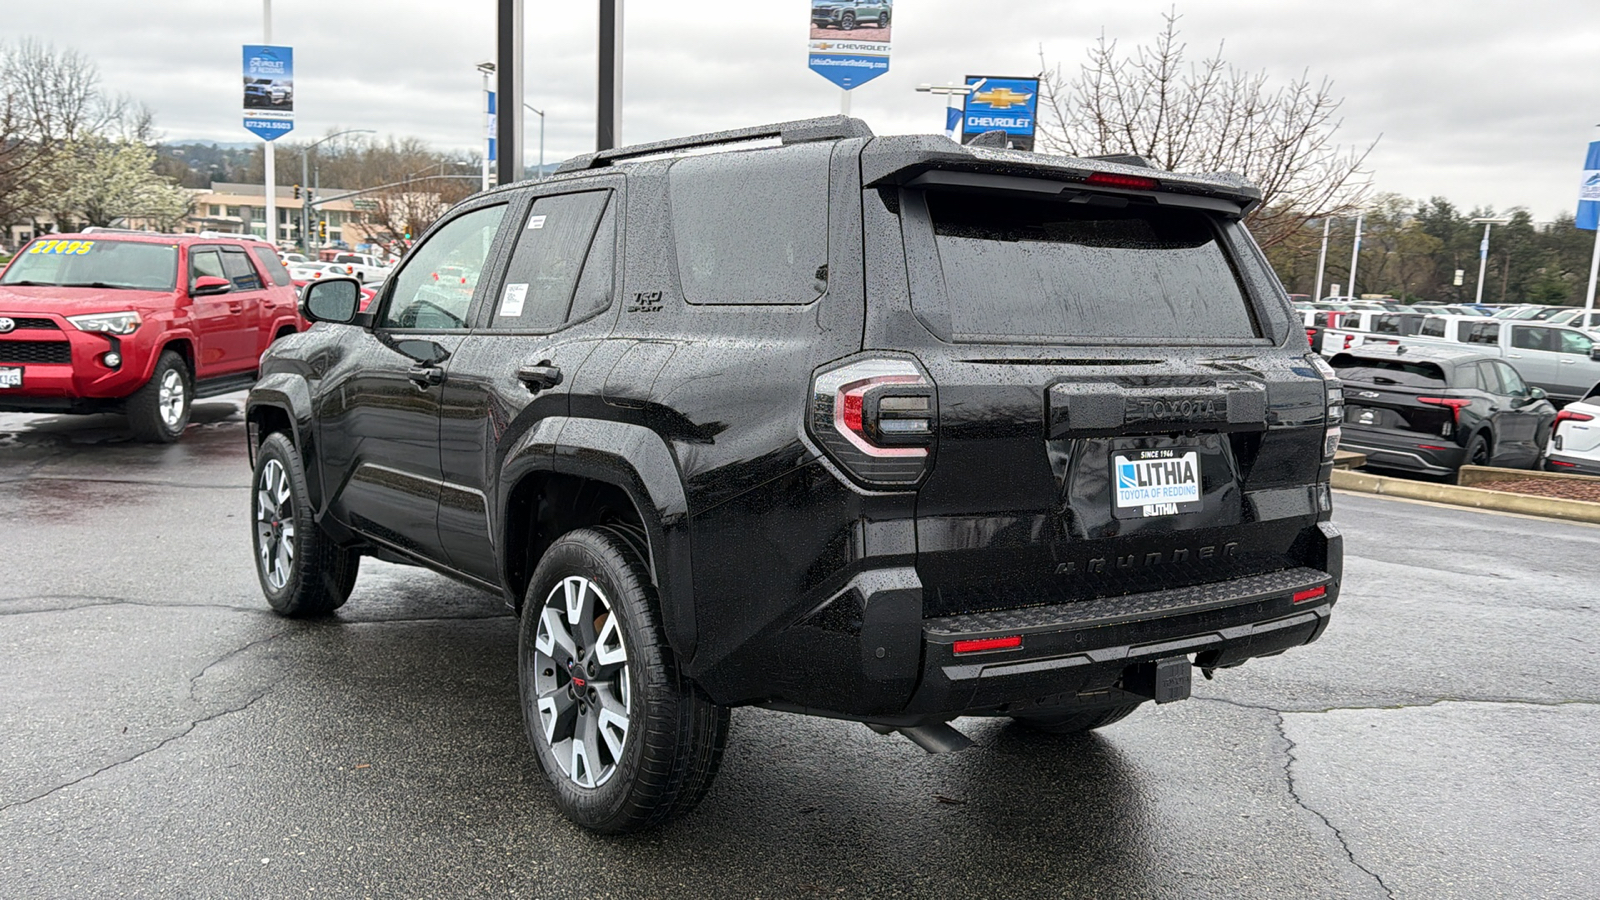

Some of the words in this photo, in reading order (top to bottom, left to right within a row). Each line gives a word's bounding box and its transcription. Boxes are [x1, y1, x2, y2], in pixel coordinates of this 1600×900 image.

[836, 43, 887, 51] CHEVROLET
[967, 117, 1030, 127] CHEVROLET
[29, 240, 95, 255] 27495
[634, 291, 662, 305] TRD
[1140, 400, 1217, 418] TOYOTA
[1140, 451, 1159, 459] SINCE
[1136, 461, 1195, 487] LITHIA
[1120, 490, 1149, 500] TOYOTA
[1151, 488, 1161, 498] OF
[1163, 486, 1196, 496] REDDING
[1152, 502, 1179, 516] LITHIA
